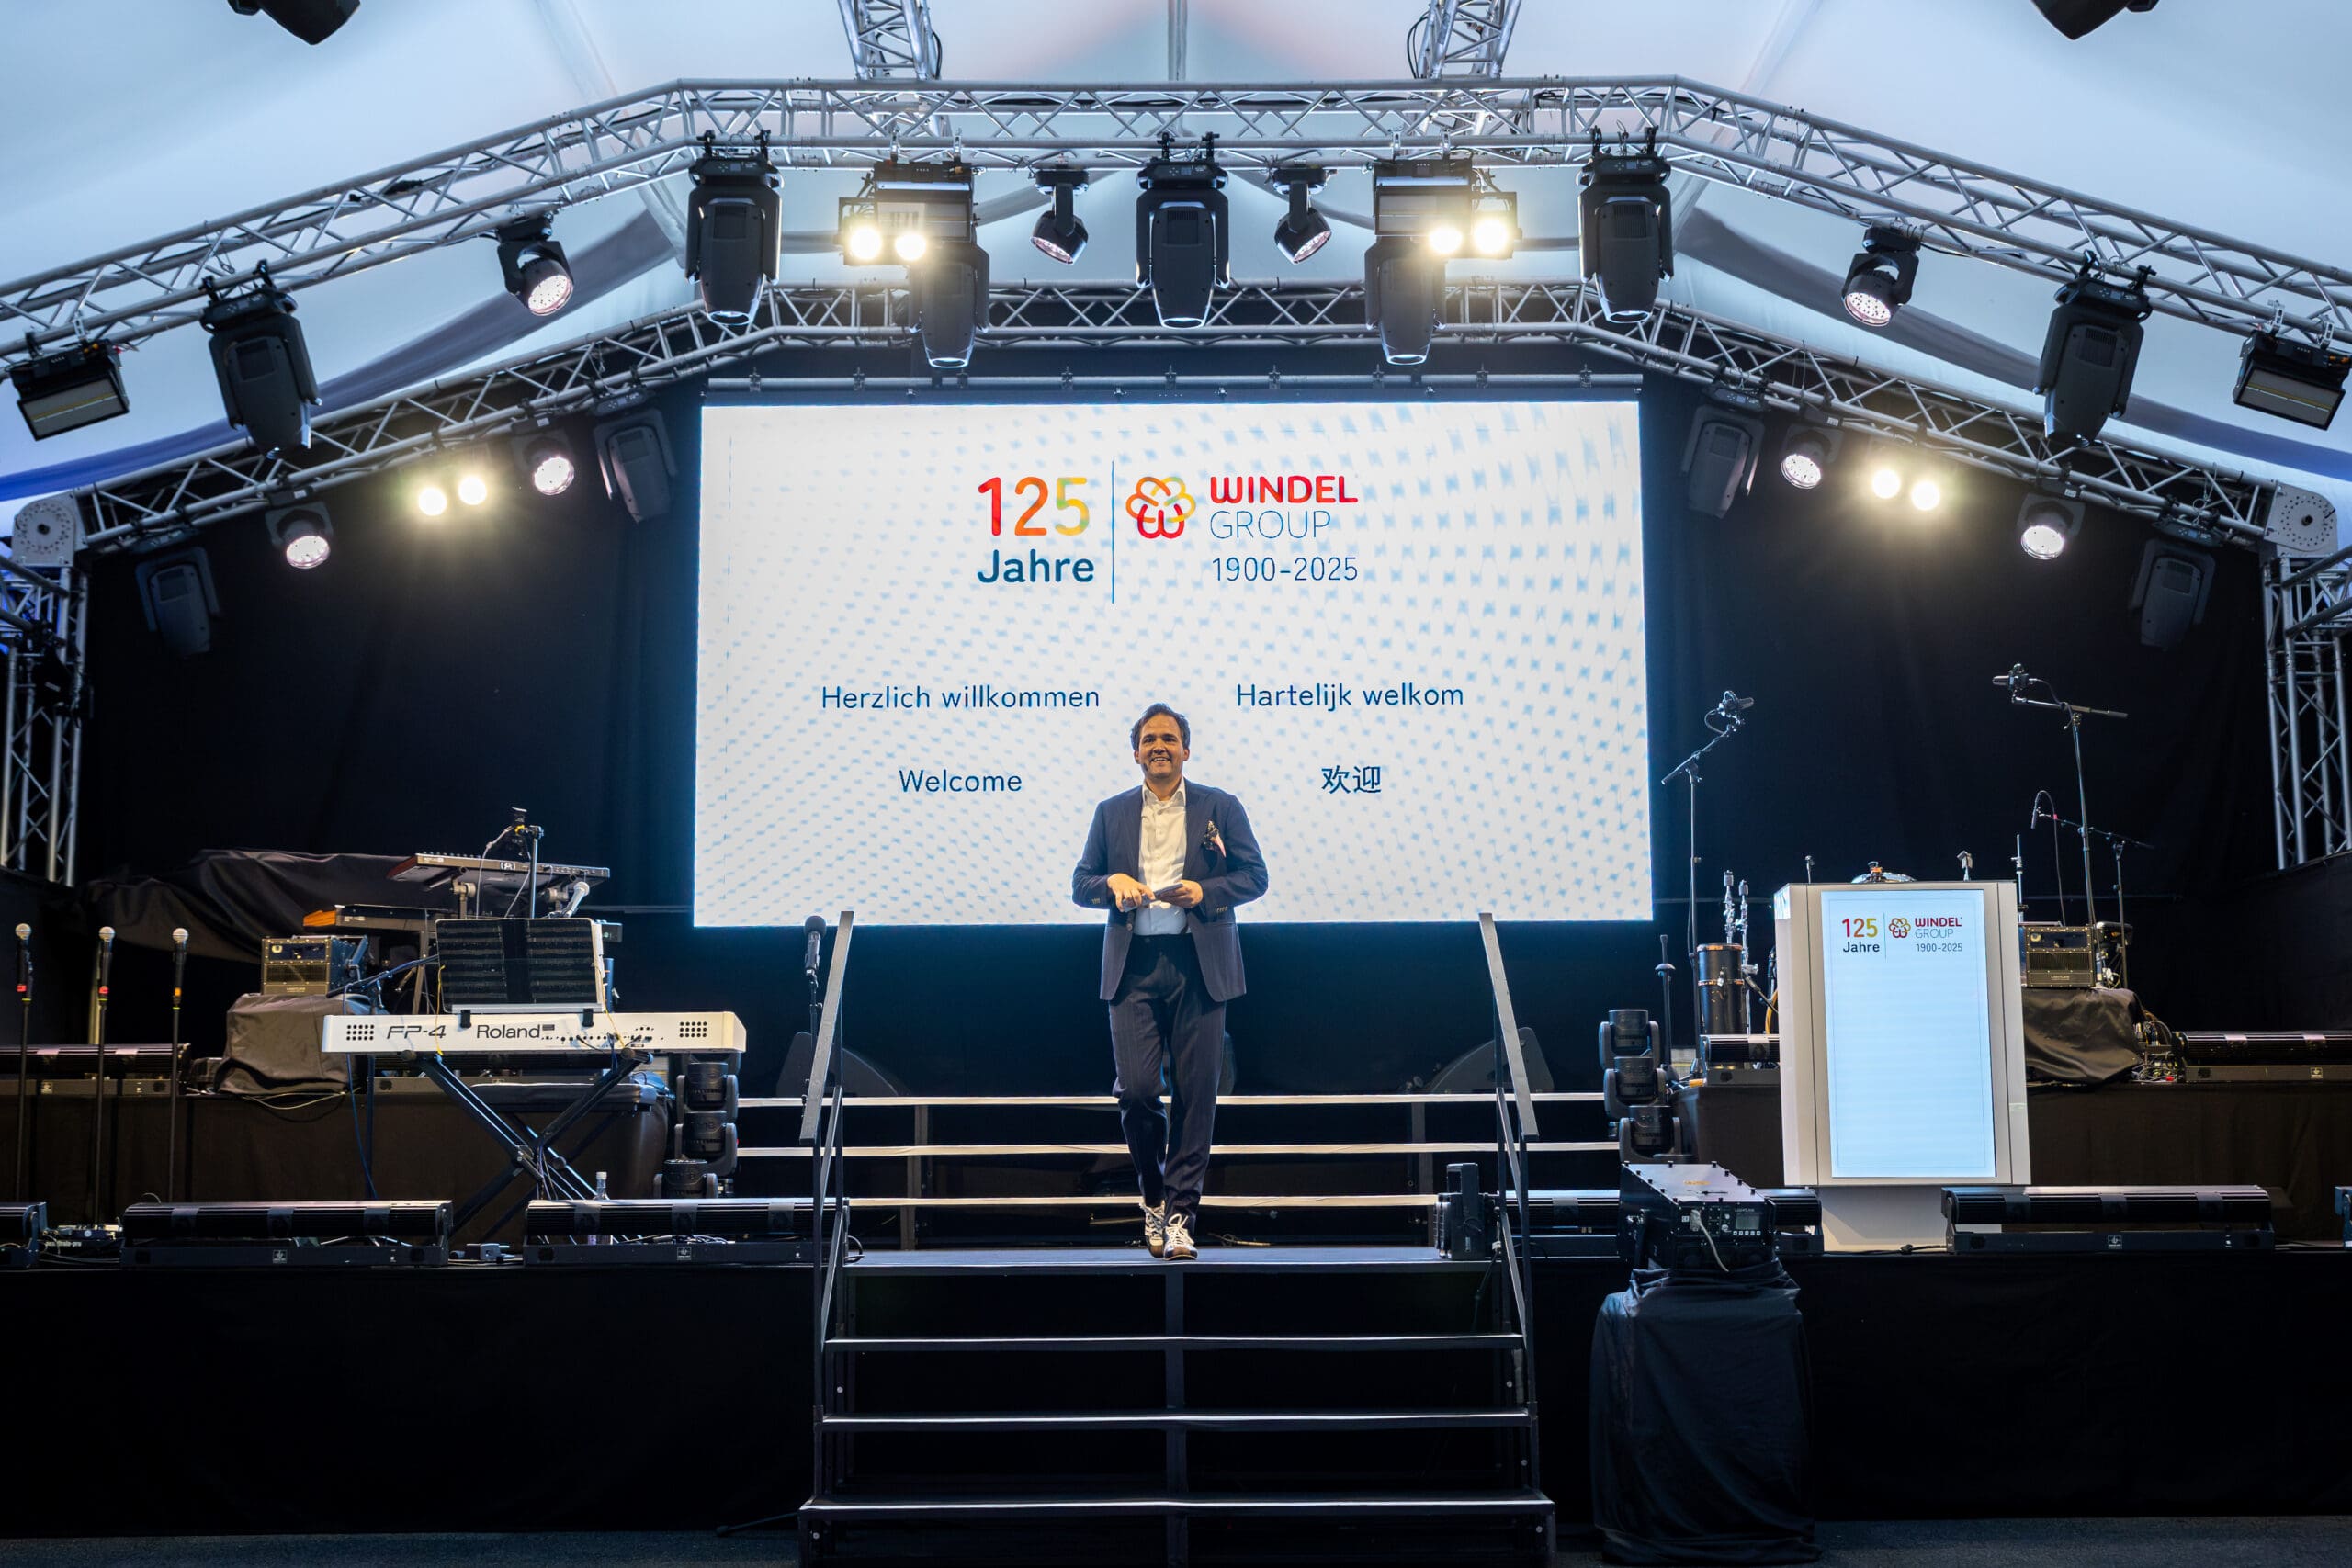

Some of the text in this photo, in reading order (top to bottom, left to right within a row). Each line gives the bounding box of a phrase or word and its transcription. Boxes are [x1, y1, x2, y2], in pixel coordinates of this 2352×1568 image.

[1210, 475, 1359, 504] WINDEL
[978, 476, 1090, 536] 125
[1210, 510, 1331, 539] GROUP
[977, 548, 1095, 583] Jahre
[1212, 556, 1358, 581] 1900-2025
[821, 684, 1100, 709] Herzlich willkommen
[1237, 682, 1464, 713] Hartelijk welkom
[899, 768, 1023, 793] Welcome
[1321, 764, 1382, 794] 欢迎
[1841, 917, 1879, 939] 125
[1914, 917, 1962, 928] WINDEL
[1914, 928, 1954, 939] GROUP
[1842, 941, 1881, 953] Jahre
[1916, 942, 1963, 953] 1900-2025
[386, 1025, 447, 1040] FP-4
[476, 1024, 540, 1039] Roland
